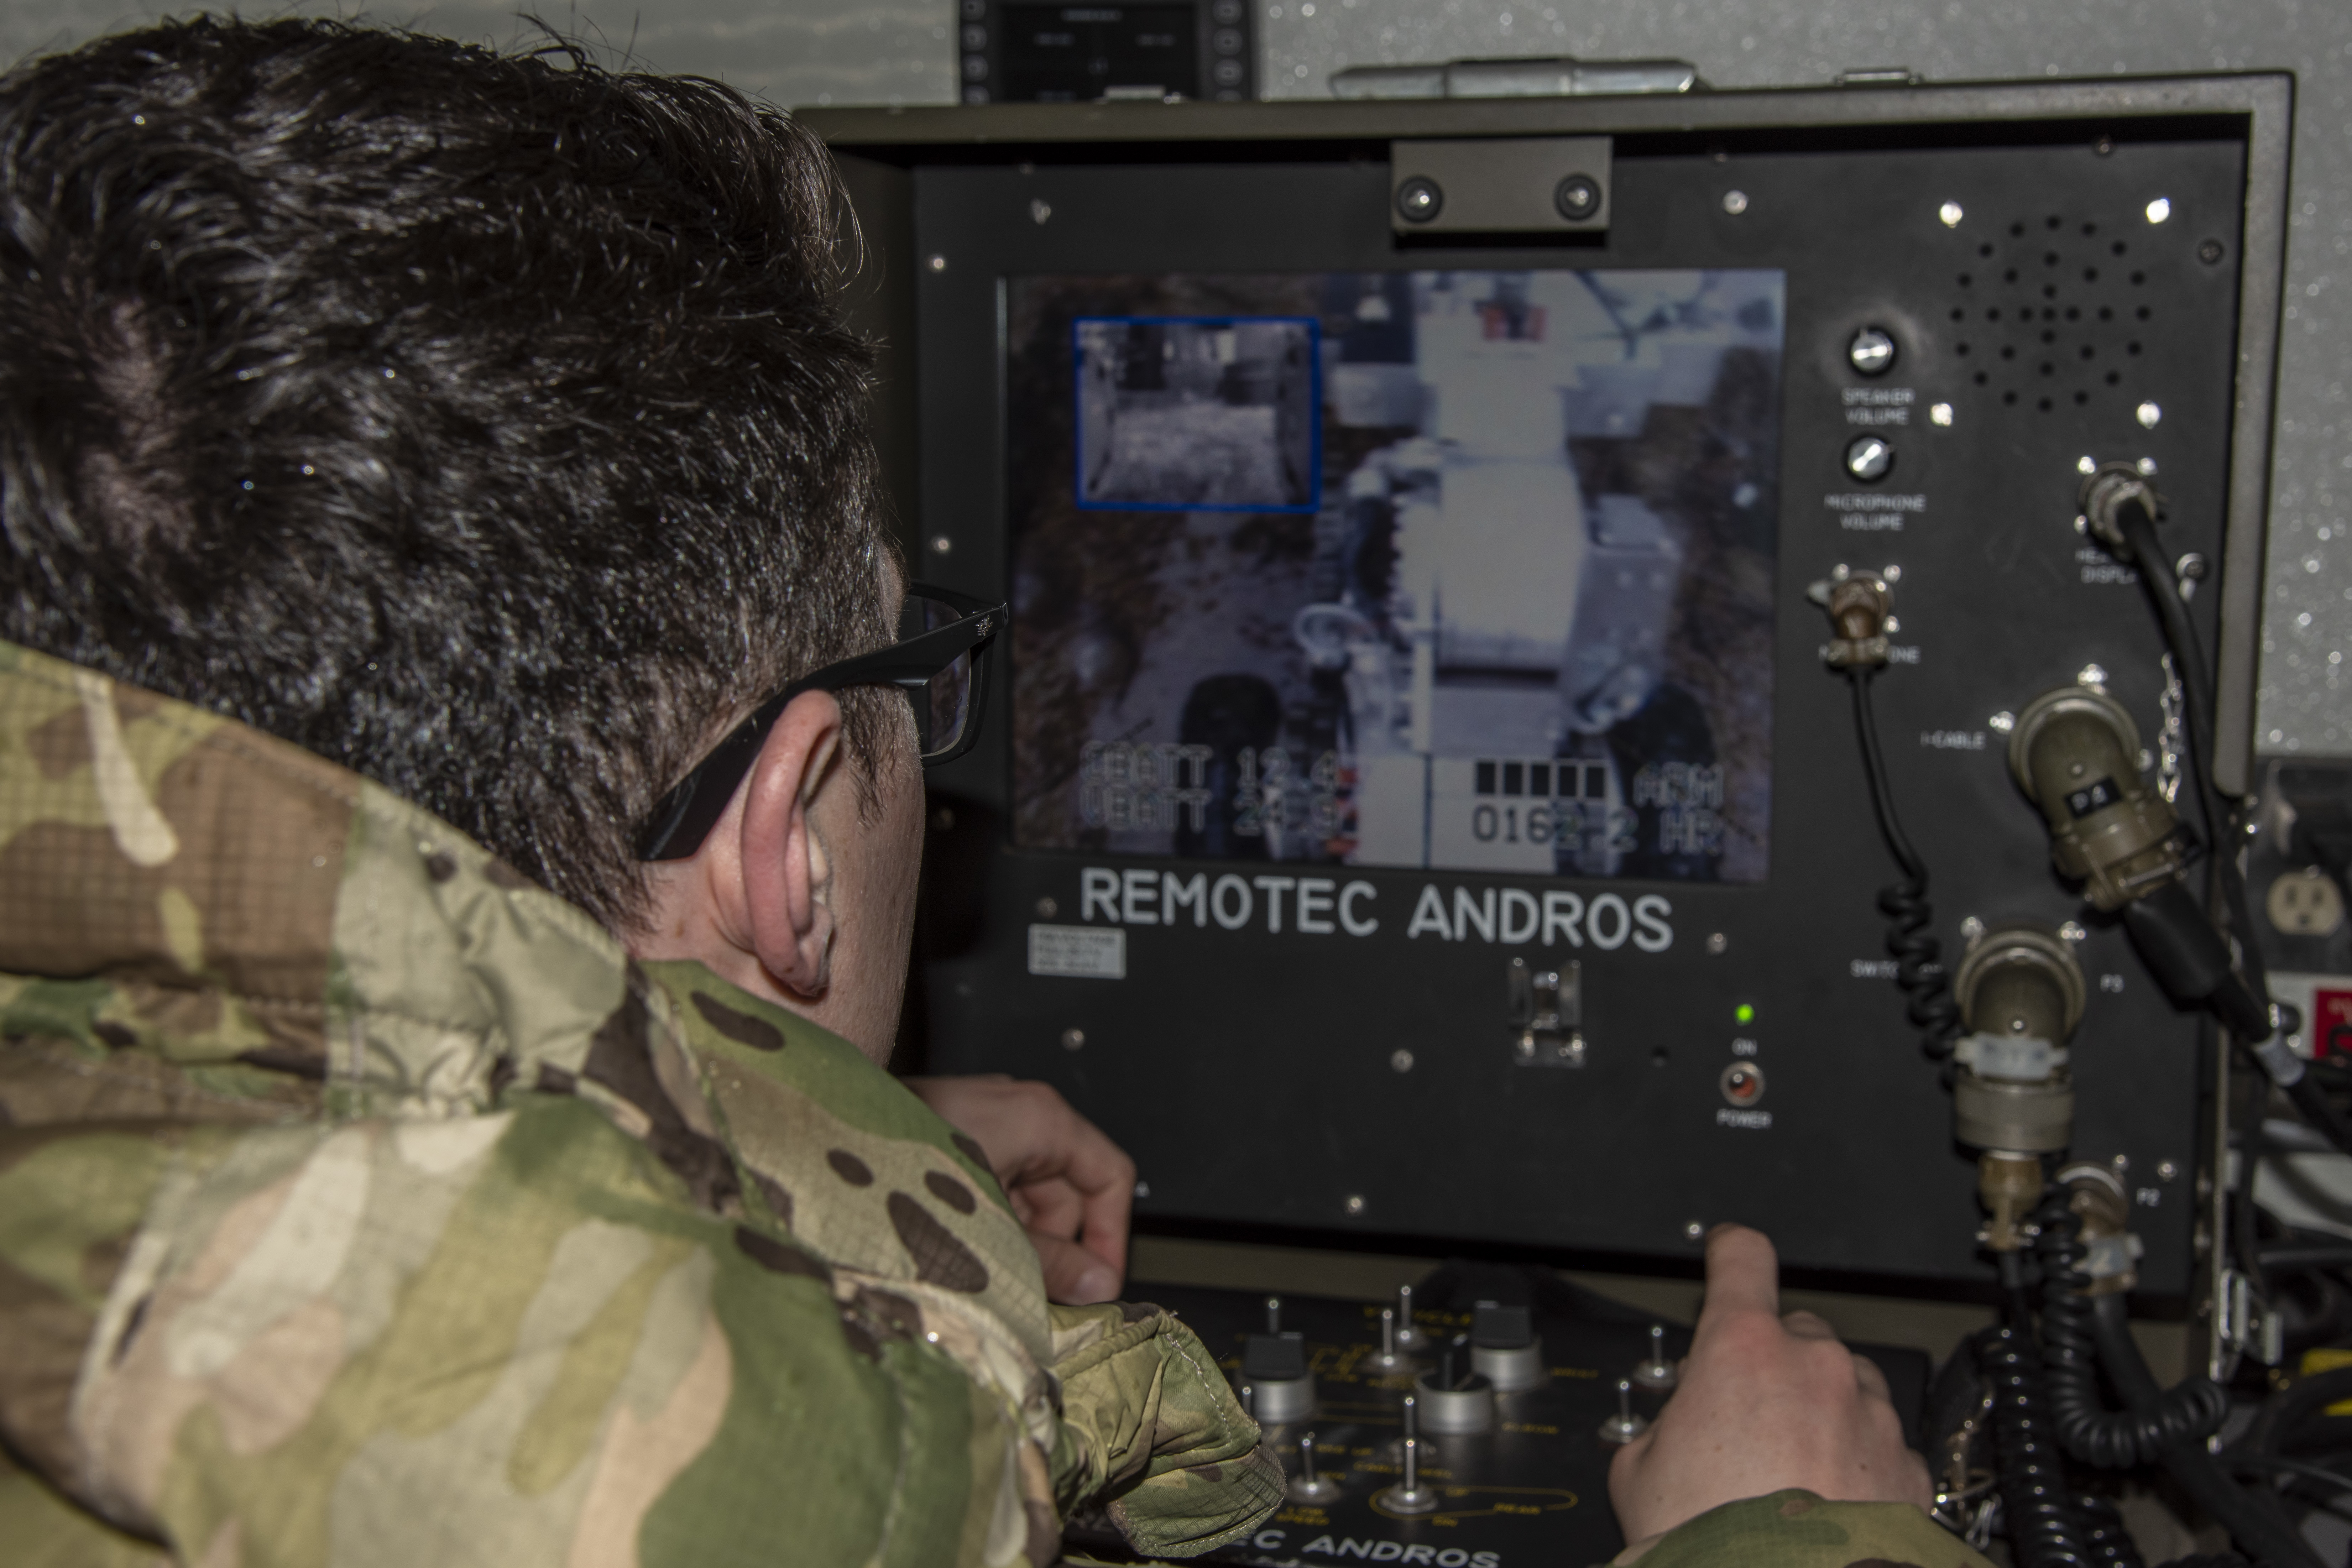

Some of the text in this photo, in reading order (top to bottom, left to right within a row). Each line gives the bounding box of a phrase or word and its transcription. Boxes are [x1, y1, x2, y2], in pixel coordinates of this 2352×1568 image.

[1841, 388, 1915, 406] SPEAKER
[1845, 408, 1909, 425] VOLUME
[1824, 493, 1927, 512] MICROPHONE
[1840, 513, 1904, 531] VOLUME
[1634, 762, 1724, 807] ARM
[1660, 809, 1725, 855] HR
[1081, 868, 1673, 952] REMOTEC ANDROS
[1731, 1038, 1757, 1056] ON
[1716, 1109, 1773, 1129] POWER
[1301, 1535, 1500, 1568] ANDROS
